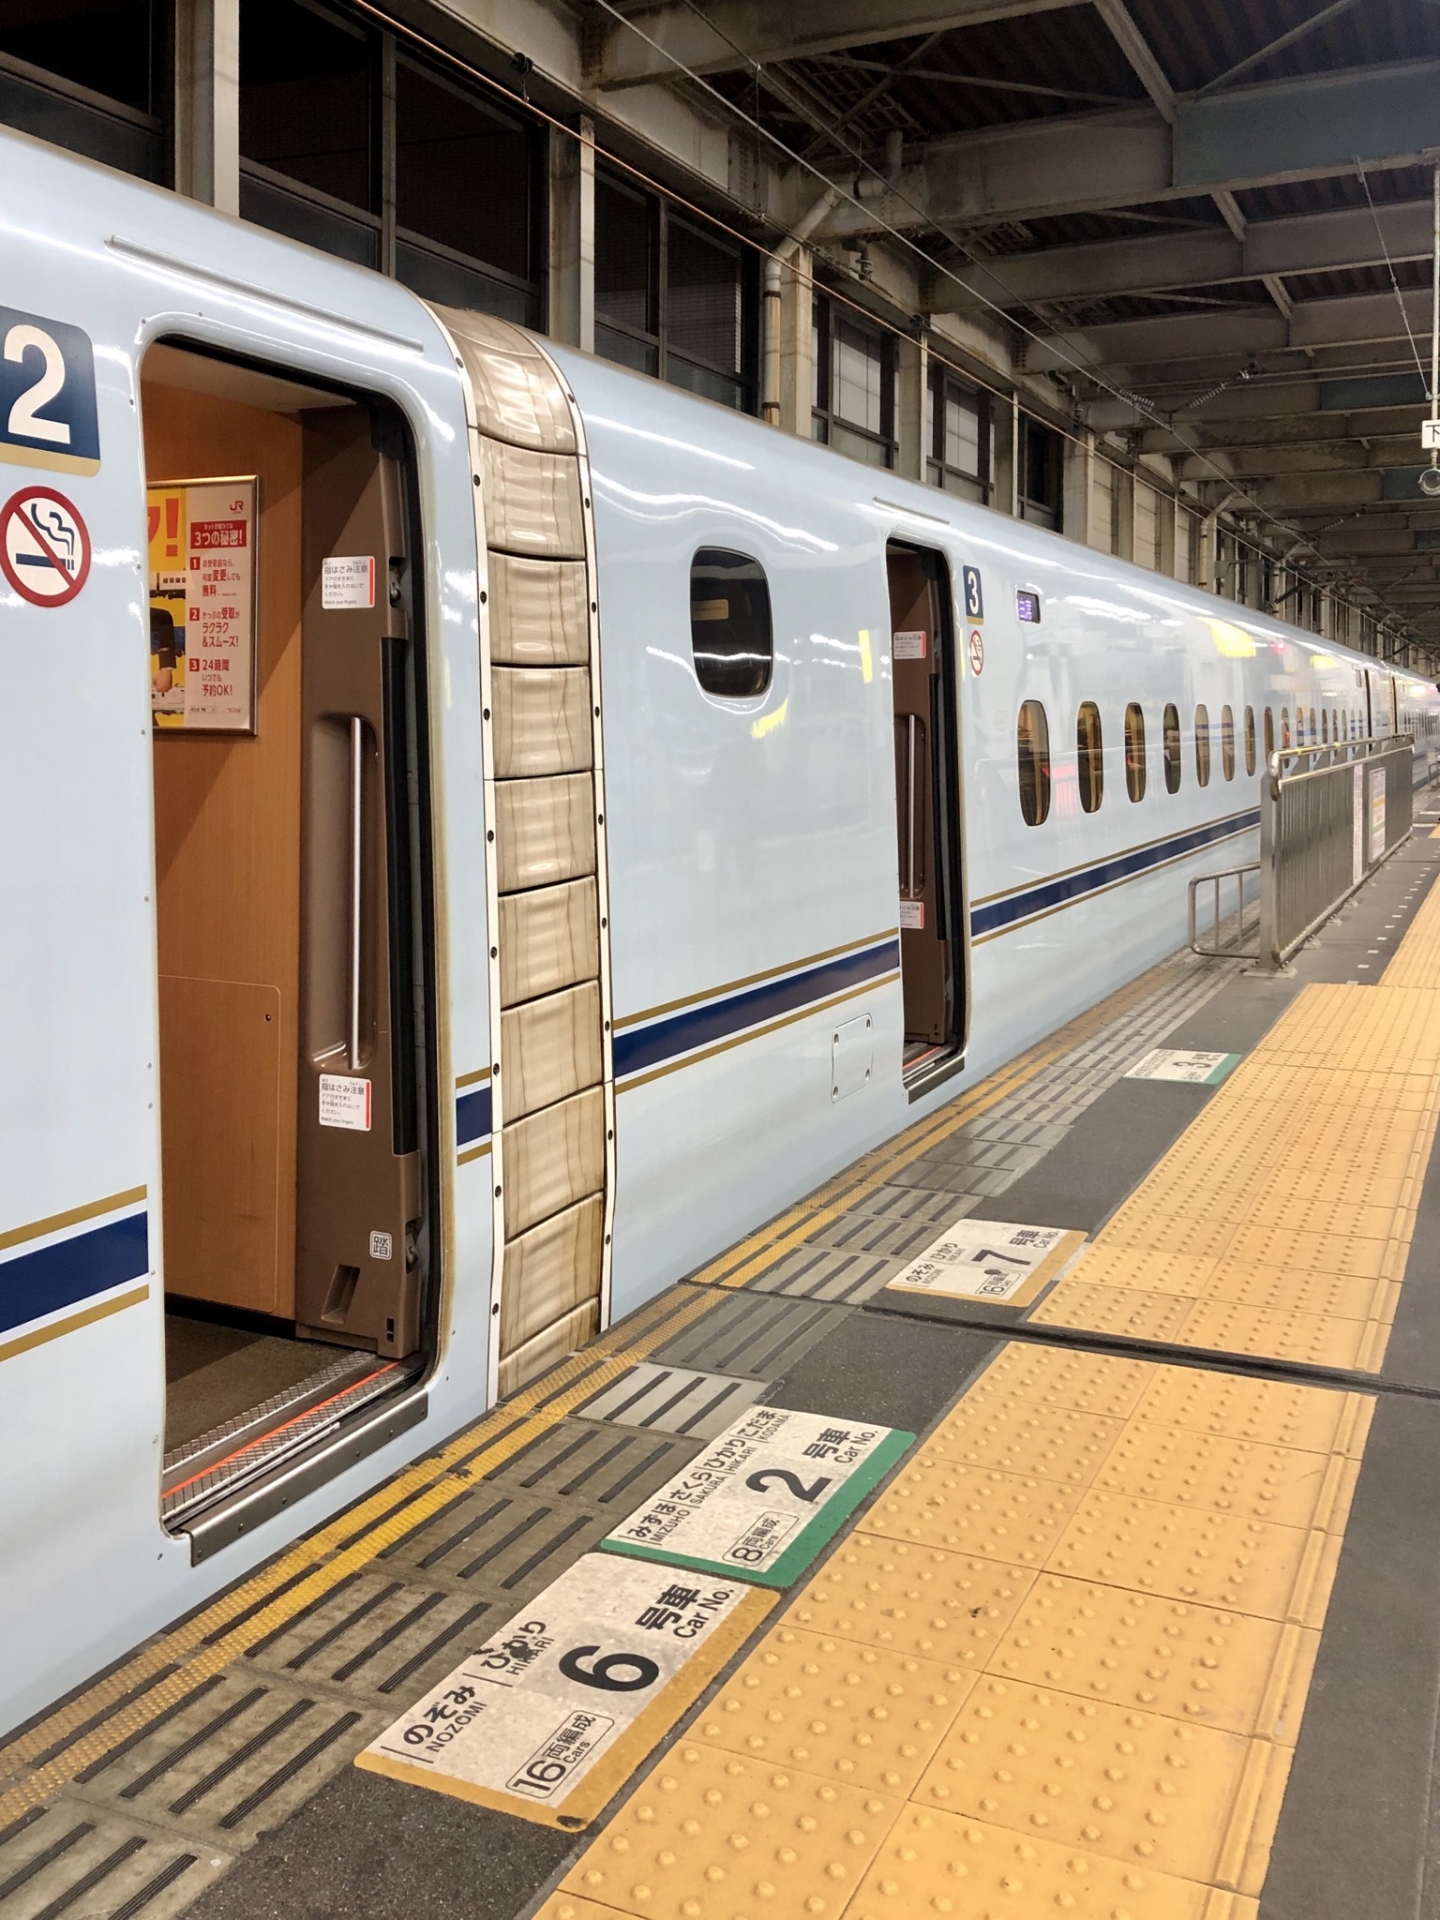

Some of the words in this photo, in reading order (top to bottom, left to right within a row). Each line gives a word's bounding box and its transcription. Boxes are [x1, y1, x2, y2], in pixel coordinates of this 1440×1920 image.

[4, 324, 71, 445] 2
[229, 500, 244, 511] JR
[202, 584, 217, 597] 無料
[968, 571, 979, 614] 3
[202, 622, 229, 634] ラクラク
[202, 659, 230, 671] 24時間
[930, 1242, 958, 1261] ひかり
[1009, 1229, 1039, 1246] 号車
[972, 1249, 1031, 1266] 7
[979, 1284, 1005, 1296] 16
[802, 1427, 851, 1460] 号車
[834, 1444, 861, 1464] Car
[852, 1429, 879, 1449] No.
[627, 1502, 677, 1539] みずほ
[670, 1471, 713, 1502] さくら
[704, 1438, 746, 1469] ひかり
[738, 1410, 777, 1438] こだま
[649, 1509, 691, 1543] MIZUHO
[689, 1475, 728, 1505] SAKURA
[725, 1446, 757, 1473] HIKARI
[757, 1414, 791, 1441] KODAMA
[745, 1468, 833, 1502] 2
[742, 1517, 781, 1548] 両編成
[759, 1533, 779, 1550] Cars
[731, 1546, 763, 1563] 8
[634, 1583, 702, 1632] 号車
[673, 1610, 711, 1639] Car
[698, 1587, 735, 1618] No.
[403, 1685, 476, 1746] のぞみ
[480, 1620, 547, 1670] ひかり
[558, 1644, 660, 1692] 6
[427, 1700, 488, 1753] NOZOMI
[506, 1636, 556, 1676] HIKARI
[544, 1713, 598, 1761] 両編成
[563, 1740, 591, 1764] Cars
[512, 1760, 568, 1793] 16
